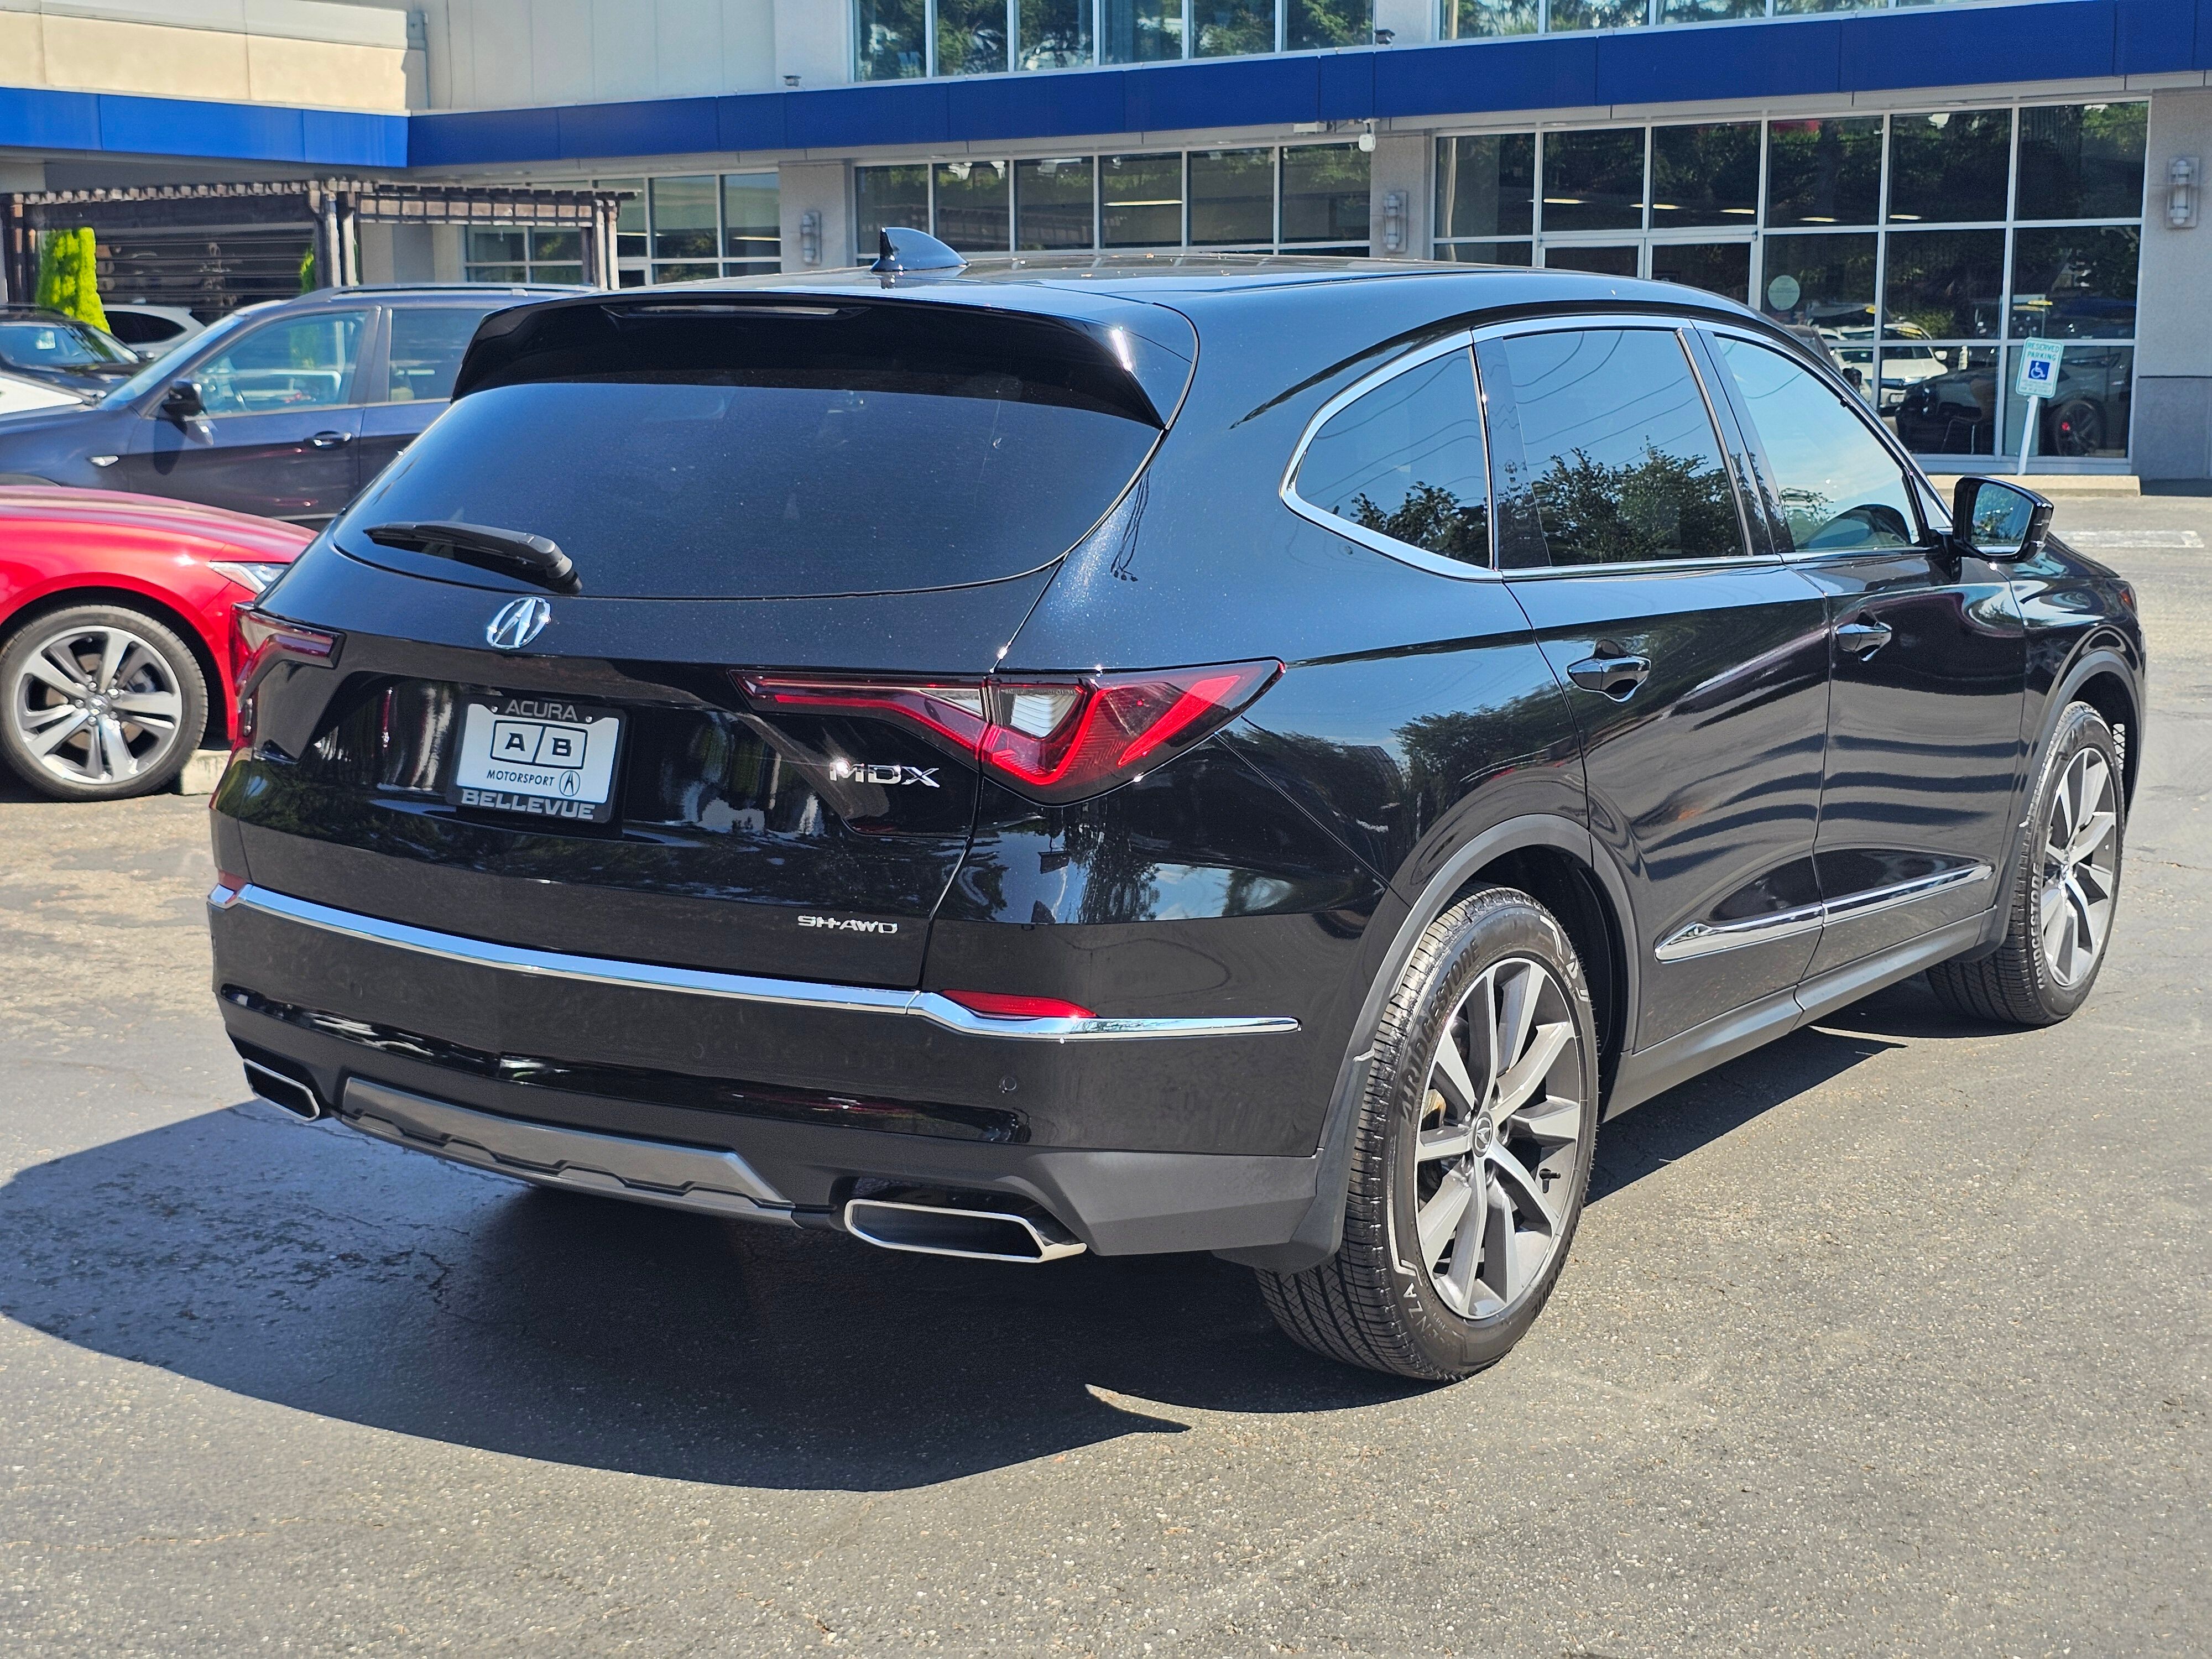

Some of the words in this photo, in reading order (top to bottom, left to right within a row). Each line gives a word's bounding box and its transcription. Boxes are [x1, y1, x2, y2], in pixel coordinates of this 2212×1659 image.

[2026, 342, 2060, 353] RESERVED
[2027, 351, 2057, 361] PARKING
[505, 699, 578, 722] ACURA
[505, 732, 526, 752] A
[552, 737, 572, 757] B
[487, 769, 555, 786] MOTORSPORT
[830, 763, 940, 788] MDX
[461, 789, 596, 820] BELLEVUE
[798, 915, 898, 934] SH-AWD
[1398, 938, 1480, 1124] BRIDGESTONE
